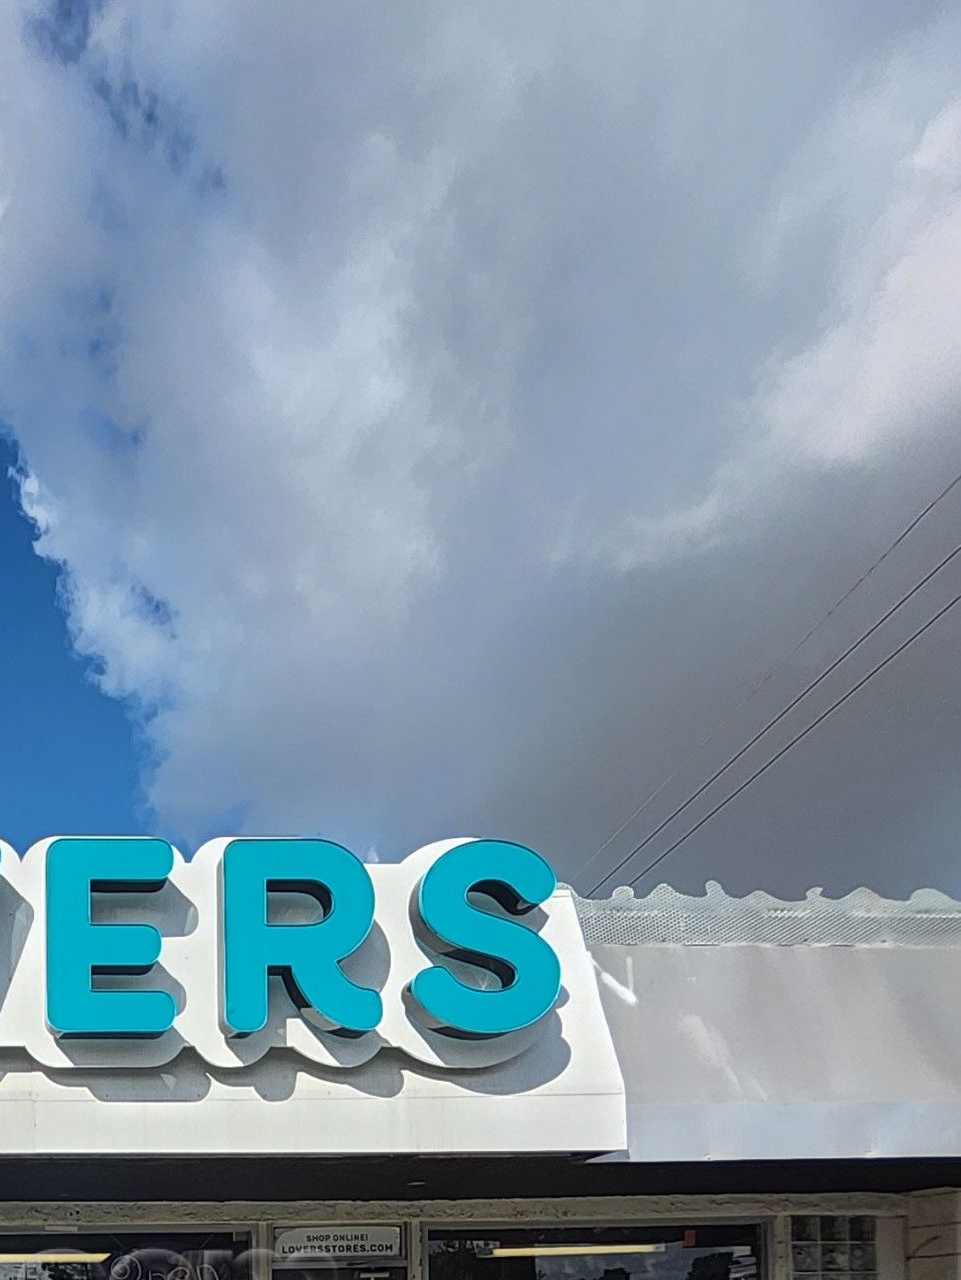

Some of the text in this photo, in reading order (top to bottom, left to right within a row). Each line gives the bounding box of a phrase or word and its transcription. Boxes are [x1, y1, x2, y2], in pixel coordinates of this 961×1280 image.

[306, 1233, 368, 1243] SHOP ONLINE!
[281, 1243, 394, 1255] LOVERSSTORES.COM
